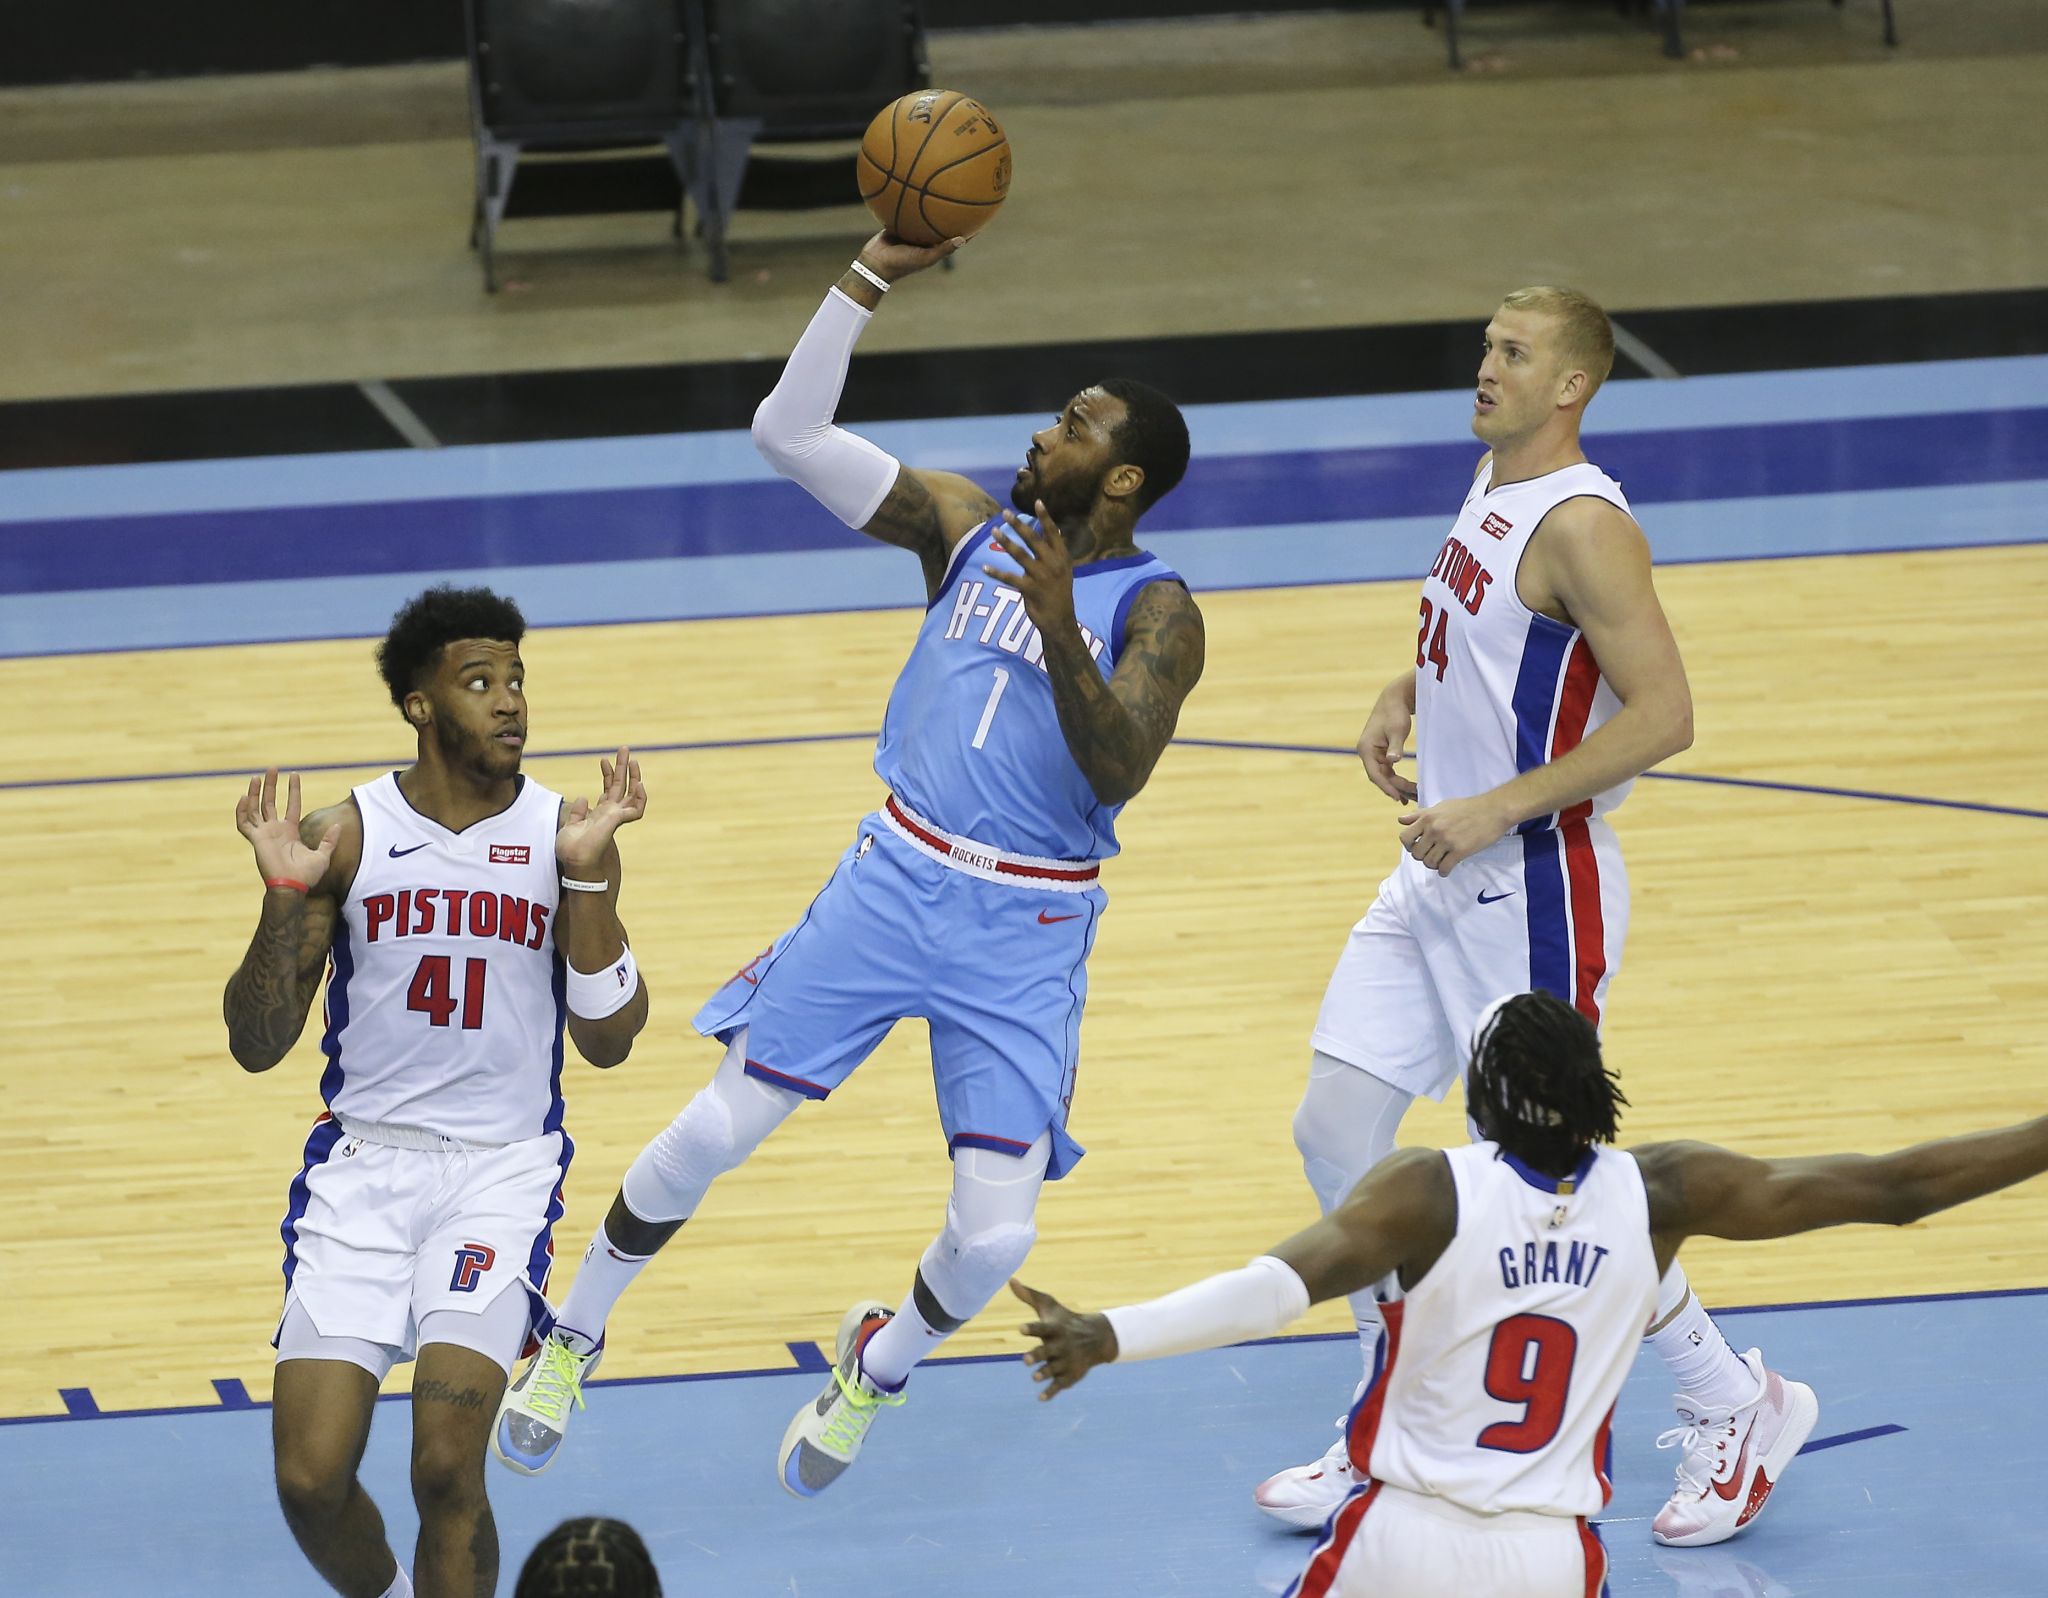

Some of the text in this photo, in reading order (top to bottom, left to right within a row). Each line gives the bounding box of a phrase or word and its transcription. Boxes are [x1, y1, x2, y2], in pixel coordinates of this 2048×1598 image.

[1416, 596, 1449, 684] 24
[971, 666, 1010, 751] 1
[491, 846, 529, 857] Flagstar
[951, 846, 995, 871] ROCKETS
[362, 888, 550, 951] PISTONS
[406, 955, 487, 1030] 41
[1498, 1240, 1609, 1289] GRANT
[1475, 1312, 1578, 1455] 9
